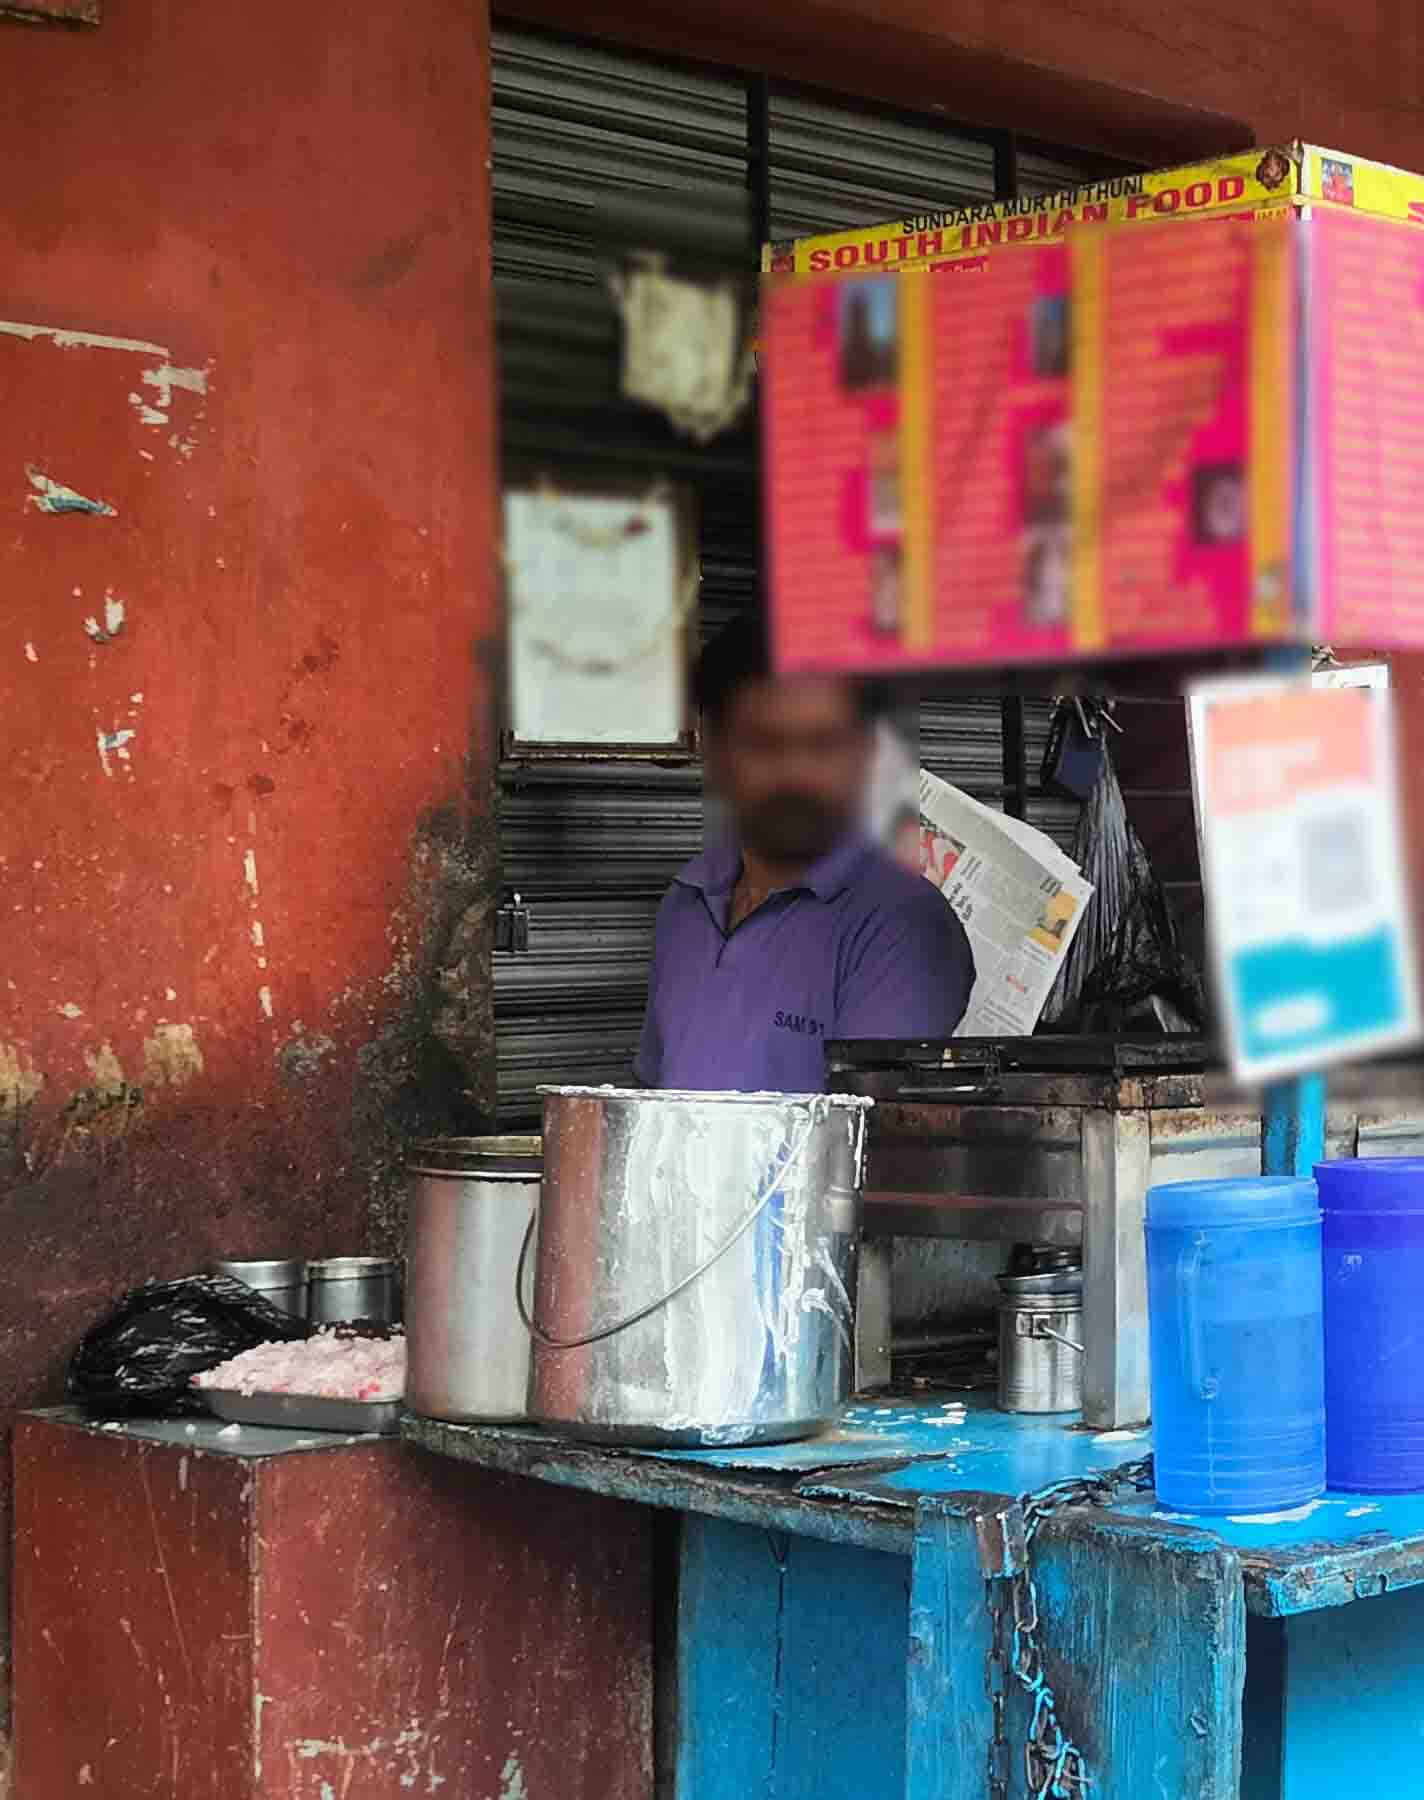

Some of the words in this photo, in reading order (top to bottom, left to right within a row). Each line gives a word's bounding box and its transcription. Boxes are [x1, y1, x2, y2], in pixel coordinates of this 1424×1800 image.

[809, 231, 943, 271] SOUTH
[962, 203, 1108, 248] INDIAN
[1125, 176, 1244, 218] FOOD
[903, 203, 996, 234] SUNDARA
[1003, 191, 1076, 217] MURTHI
[1083, 176, 1143, 203] THUNI
